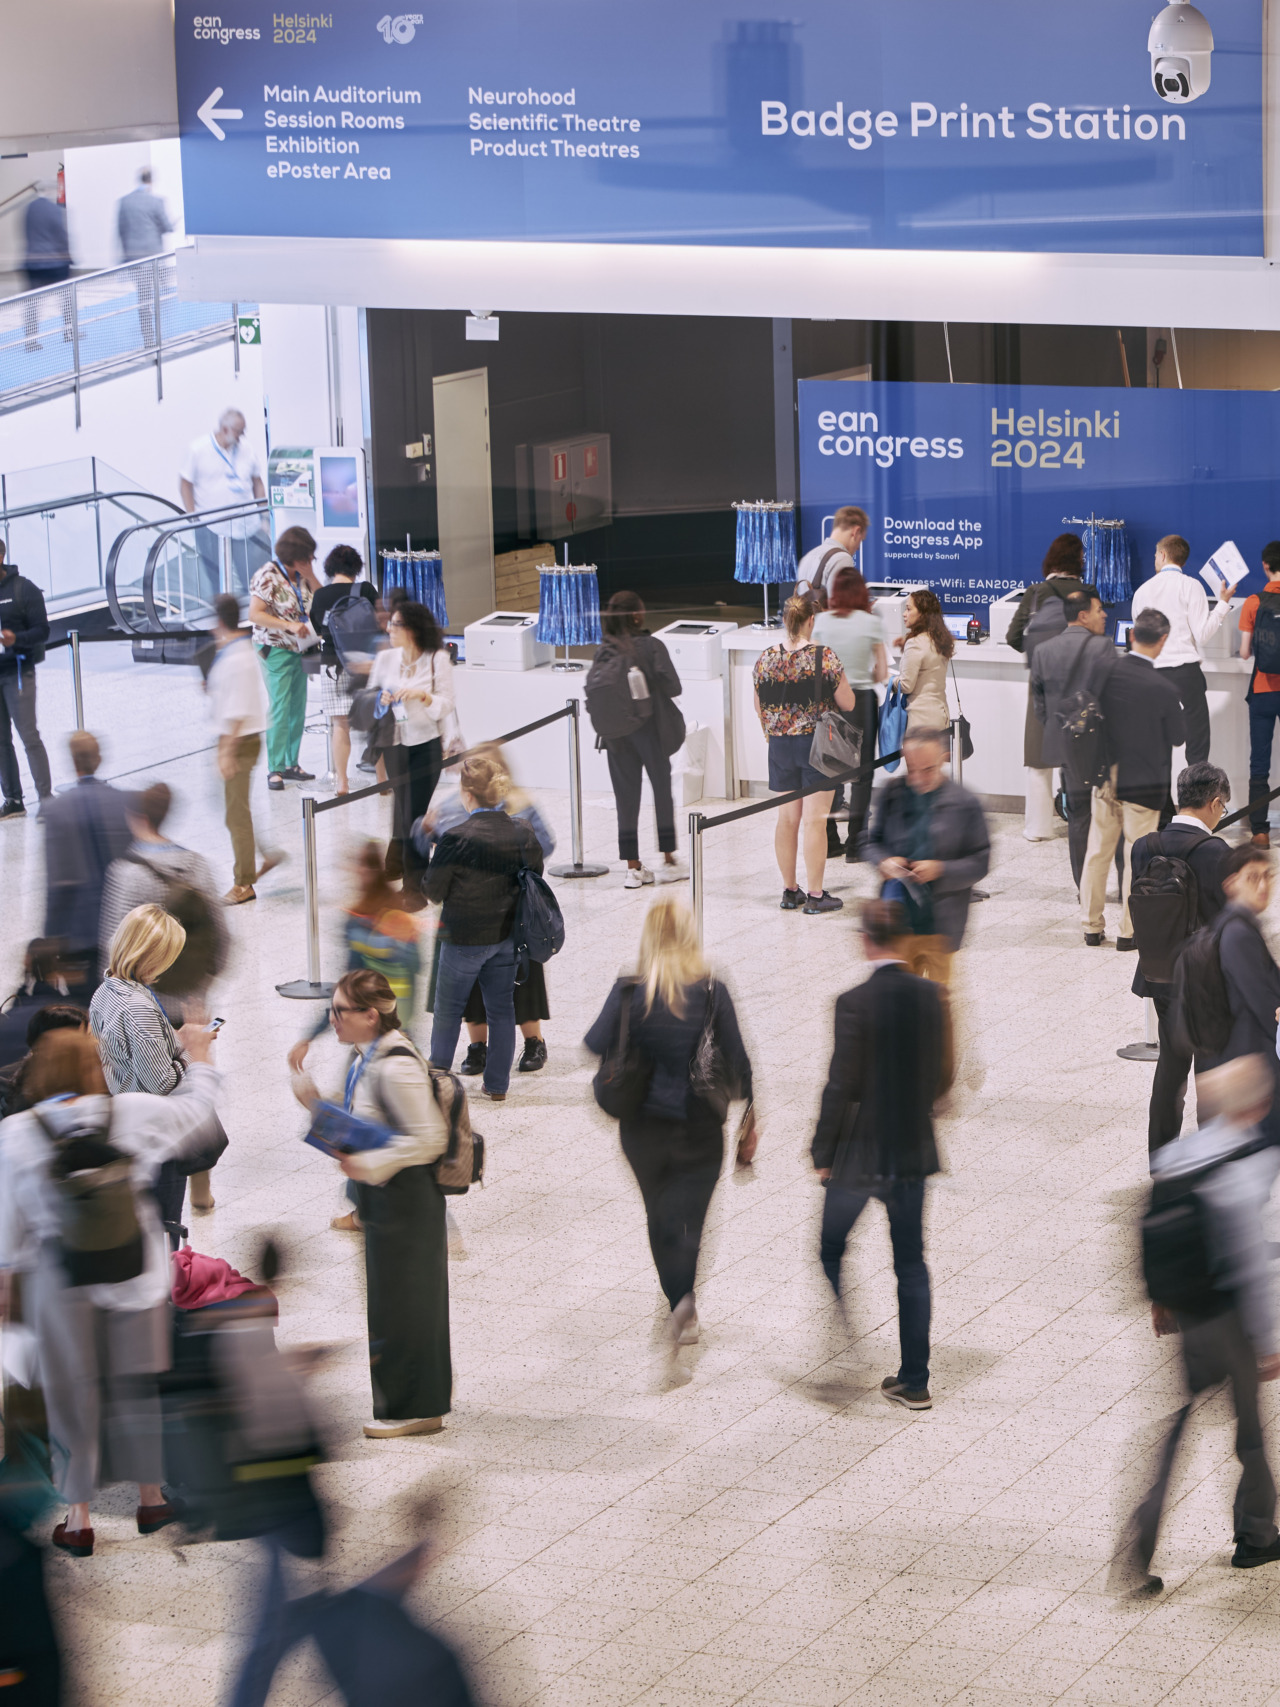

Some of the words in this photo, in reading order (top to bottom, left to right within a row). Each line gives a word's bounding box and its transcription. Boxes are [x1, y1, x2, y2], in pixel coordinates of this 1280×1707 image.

[193, 16, 222, 28] ean
[274, 14, 332, 27] Helsinki
[193, 27, 261, 45] congress
[274, 29, 316, 43] 2024
[264, 85, 309, 102] Main
[314, 86, 421, 103] Auditorium
[469, 87, 575, 105] Neurohood
[265, 110, 336, 128] Session
[341, 111, 404, 129] Rooms
[469, 112, 557, 132] Scientific
[562, 114, 640, 132] Theatre
[762, 101, 898, 150] Badge
[911, 102, 1015, 138] Print
[1026, 103, 1186, 141] Station
[266, 136, 359, 154] Exhibition
[471, 139, 547, 156] Product
[551, 140, 639, 158] Theatres
[267, 161, 339, 179] ePoster
[344, 162, 390, 180] Area
[818, 410, 878, 432] ean
[991, 408, 1120, 438] Helsinki
[818, 435, 964, 468] congress
[992, 440, 1085, 469] 2024
[884, 517, 955, 531] Download
[962, 519, 982, 532] the
[884, 532, 949, 548] Congress
[953, 534, 982, 549] App
[969, 579, 1025, 589] EAN2024
